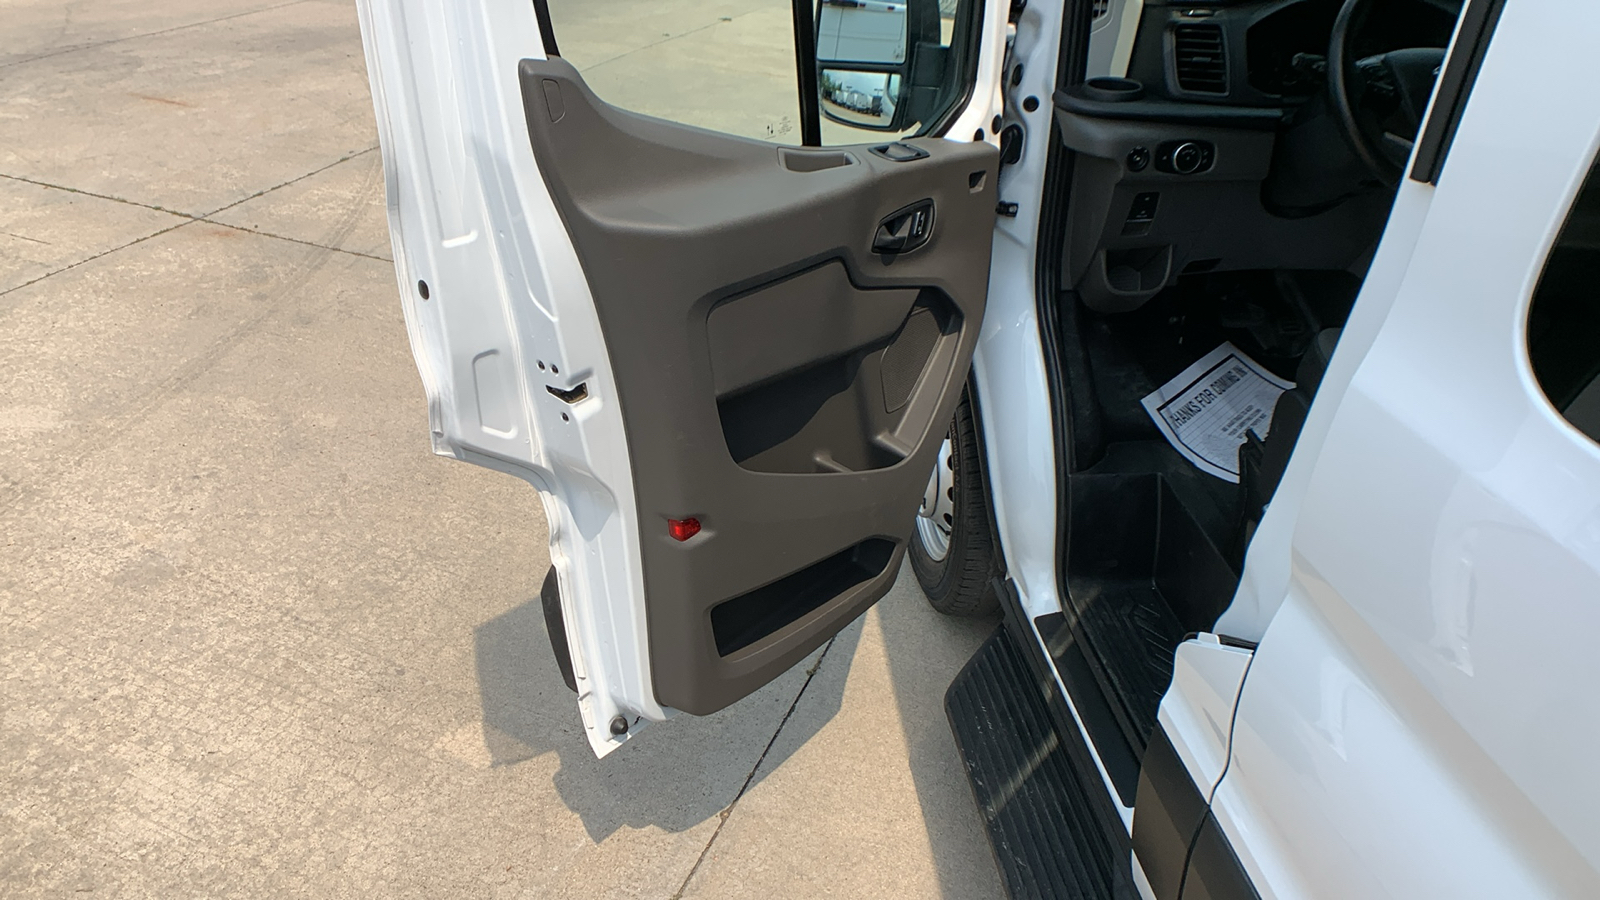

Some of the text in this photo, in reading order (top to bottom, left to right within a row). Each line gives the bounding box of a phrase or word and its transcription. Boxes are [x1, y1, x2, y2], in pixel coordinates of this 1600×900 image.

[1170, 401, 1202, 428] THANKS
[1194, 389, 1217, 408] FOR
[1210, 371, 1240, 395] COMING
[1233, 365, 1248, 378] IN
